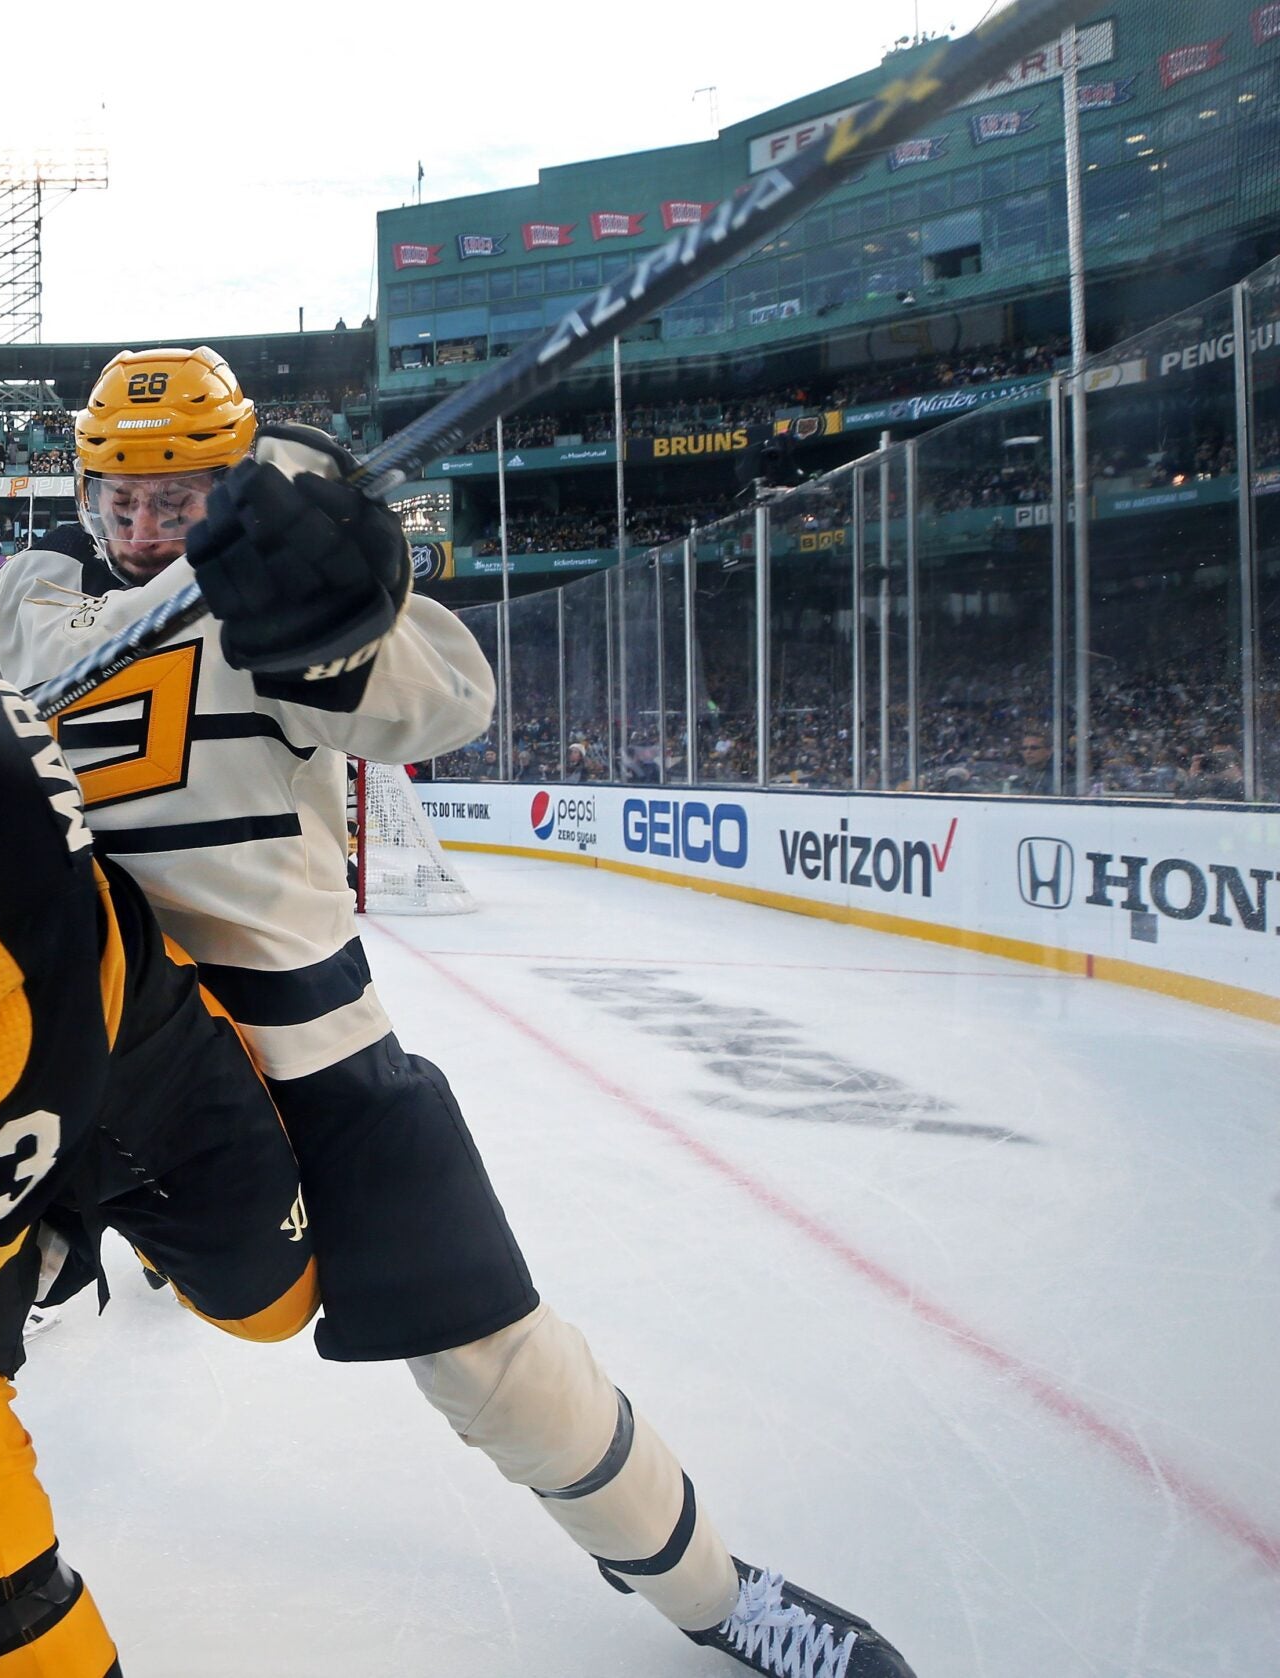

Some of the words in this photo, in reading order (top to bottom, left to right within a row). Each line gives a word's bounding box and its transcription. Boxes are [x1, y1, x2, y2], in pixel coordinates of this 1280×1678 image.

[537, 168, 794, 363] ALPHA
[128, 373, 168, 395] 28
[908, 391, 978, 420] Winter
[117, 418, 171, 429] WARRIOR
[653, 429, 748, 457] BRUINS
[101, 654, 134, 679] ALPHA
[439, 802, 450, 818] DO
[451, 802, 466, 819] THE
[557, 794, 596, 827] pepsi
[557, 829, 575, 842] ZERO
[576, 831, 597, 844] SUGAR
[623, 798, 748, 869] GEICO
[779, 817, 932, 898] verizon
[1085, 851, 1280, 936] HON
